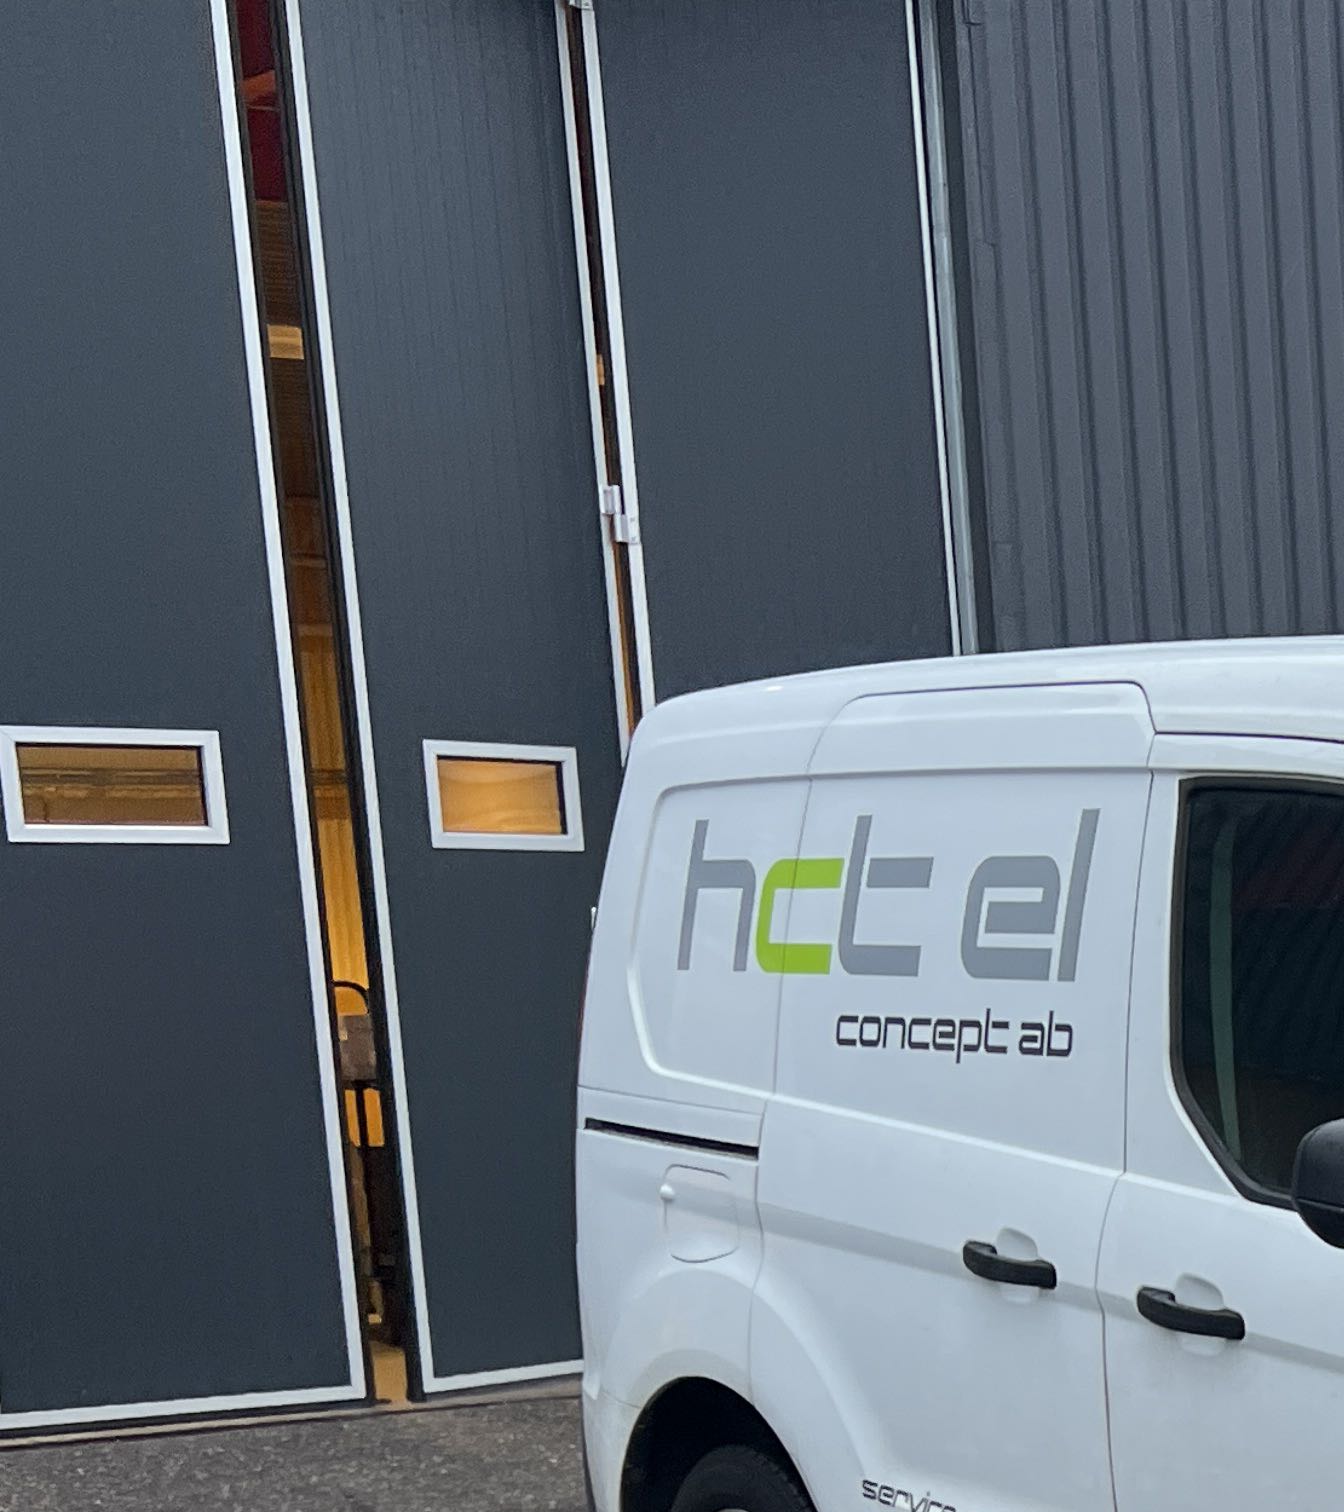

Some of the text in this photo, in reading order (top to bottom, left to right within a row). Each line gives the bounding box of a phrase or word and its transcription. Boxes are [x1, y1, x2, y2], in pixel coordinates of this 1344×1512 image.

[960, 808, 1101, 982] el
[836, 1007, 1073, 1063] concept ab
